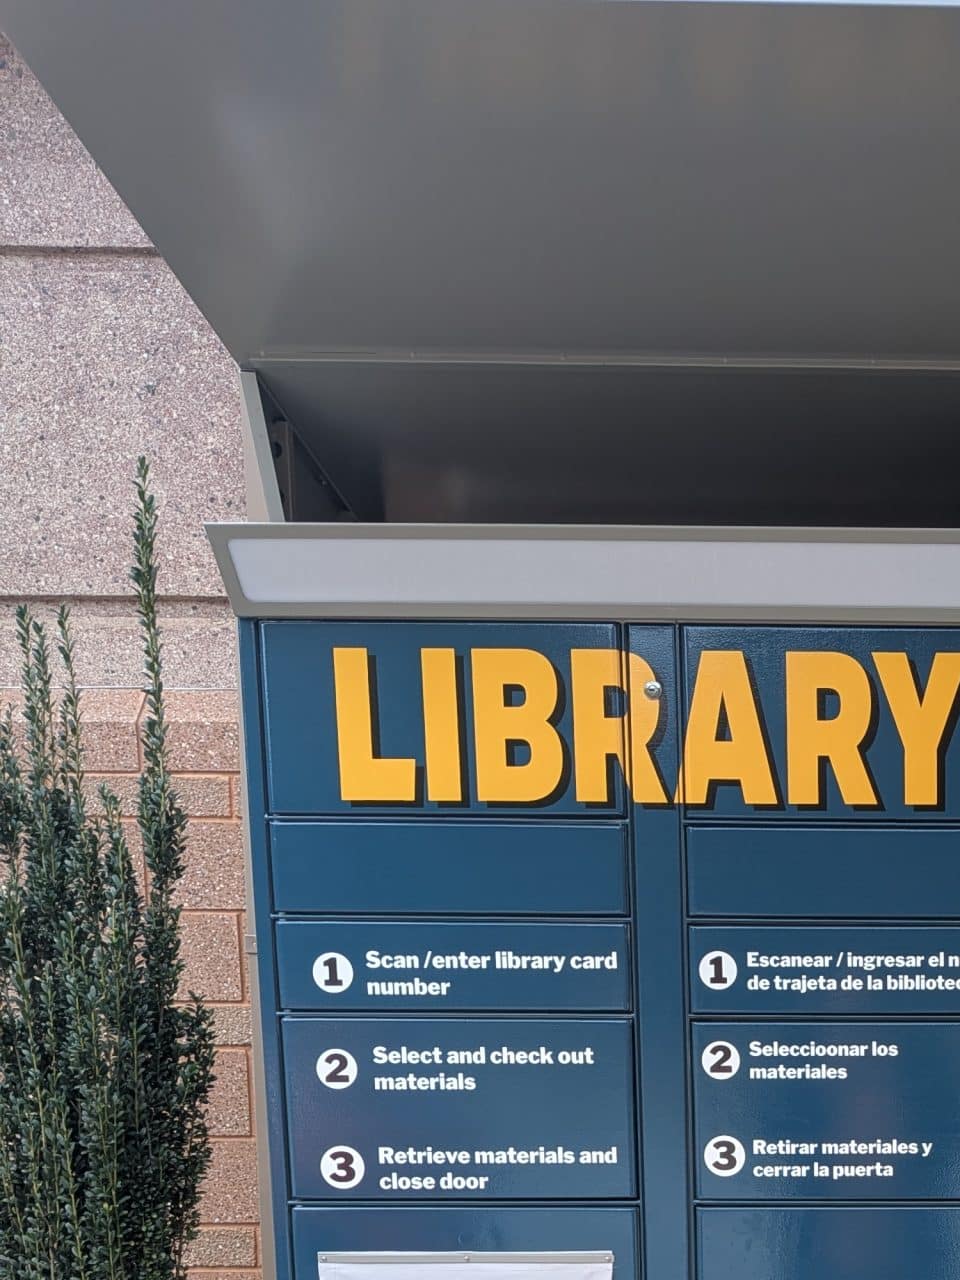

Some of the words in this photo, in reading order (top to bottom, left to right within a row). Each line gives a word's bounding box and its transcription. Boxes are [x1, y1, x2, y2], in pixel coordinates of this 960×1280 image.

[365, 950, 420, 969] Scan
[494, 950, 565, 973] library
[569, 951, 618, 970] card
[746, 951, 833, 968] Escanear
[846, 951, 925, 971] ingresar
[927, 951, 945, 968] el
[366, 977, 451, 996] number
[746, 974, 771, 991] de
[773, 974, 838, 994] trajeta
[840, 974, 864, 991] de
[866, 974, 884, 991] la
[372, 1045, 443, 1065] Select
[446, 1046, 486, 1065] and
[489, 1046, 554, 1065] check
[557, 1047, 595, 1065] out
[749, 1040, 869, 1057] Seleccioonar
[871, 1040, 899, 1057] los
[325, 1053, 350, 1083] 2
[710, 1046, 733, 1073] 2
[749, 1063, 848, 1080] materiales
[374, 1072, 477, 1091] materials
[378, 1146, 471, 1165] Retrieve
[474, 1146, 576, 1165] materials
[578, 1146, 618, 1165] and
[712, 1140, 737, 1170] 3
[752, 1139, 818, 1155] Retirar
[821, 1138, 918, 1155] materiales
[921, 1142, 933, 1157] y
[329, 1151, 356, 1182] 3
[752, 1165, 811, 1178] cerrar
[813, 1161, 830, 1177] la
[832, 1161, 894, 1180] puerta
[379, 1172, 436, 1190] close
[439, 1171, 489, 1190] door
